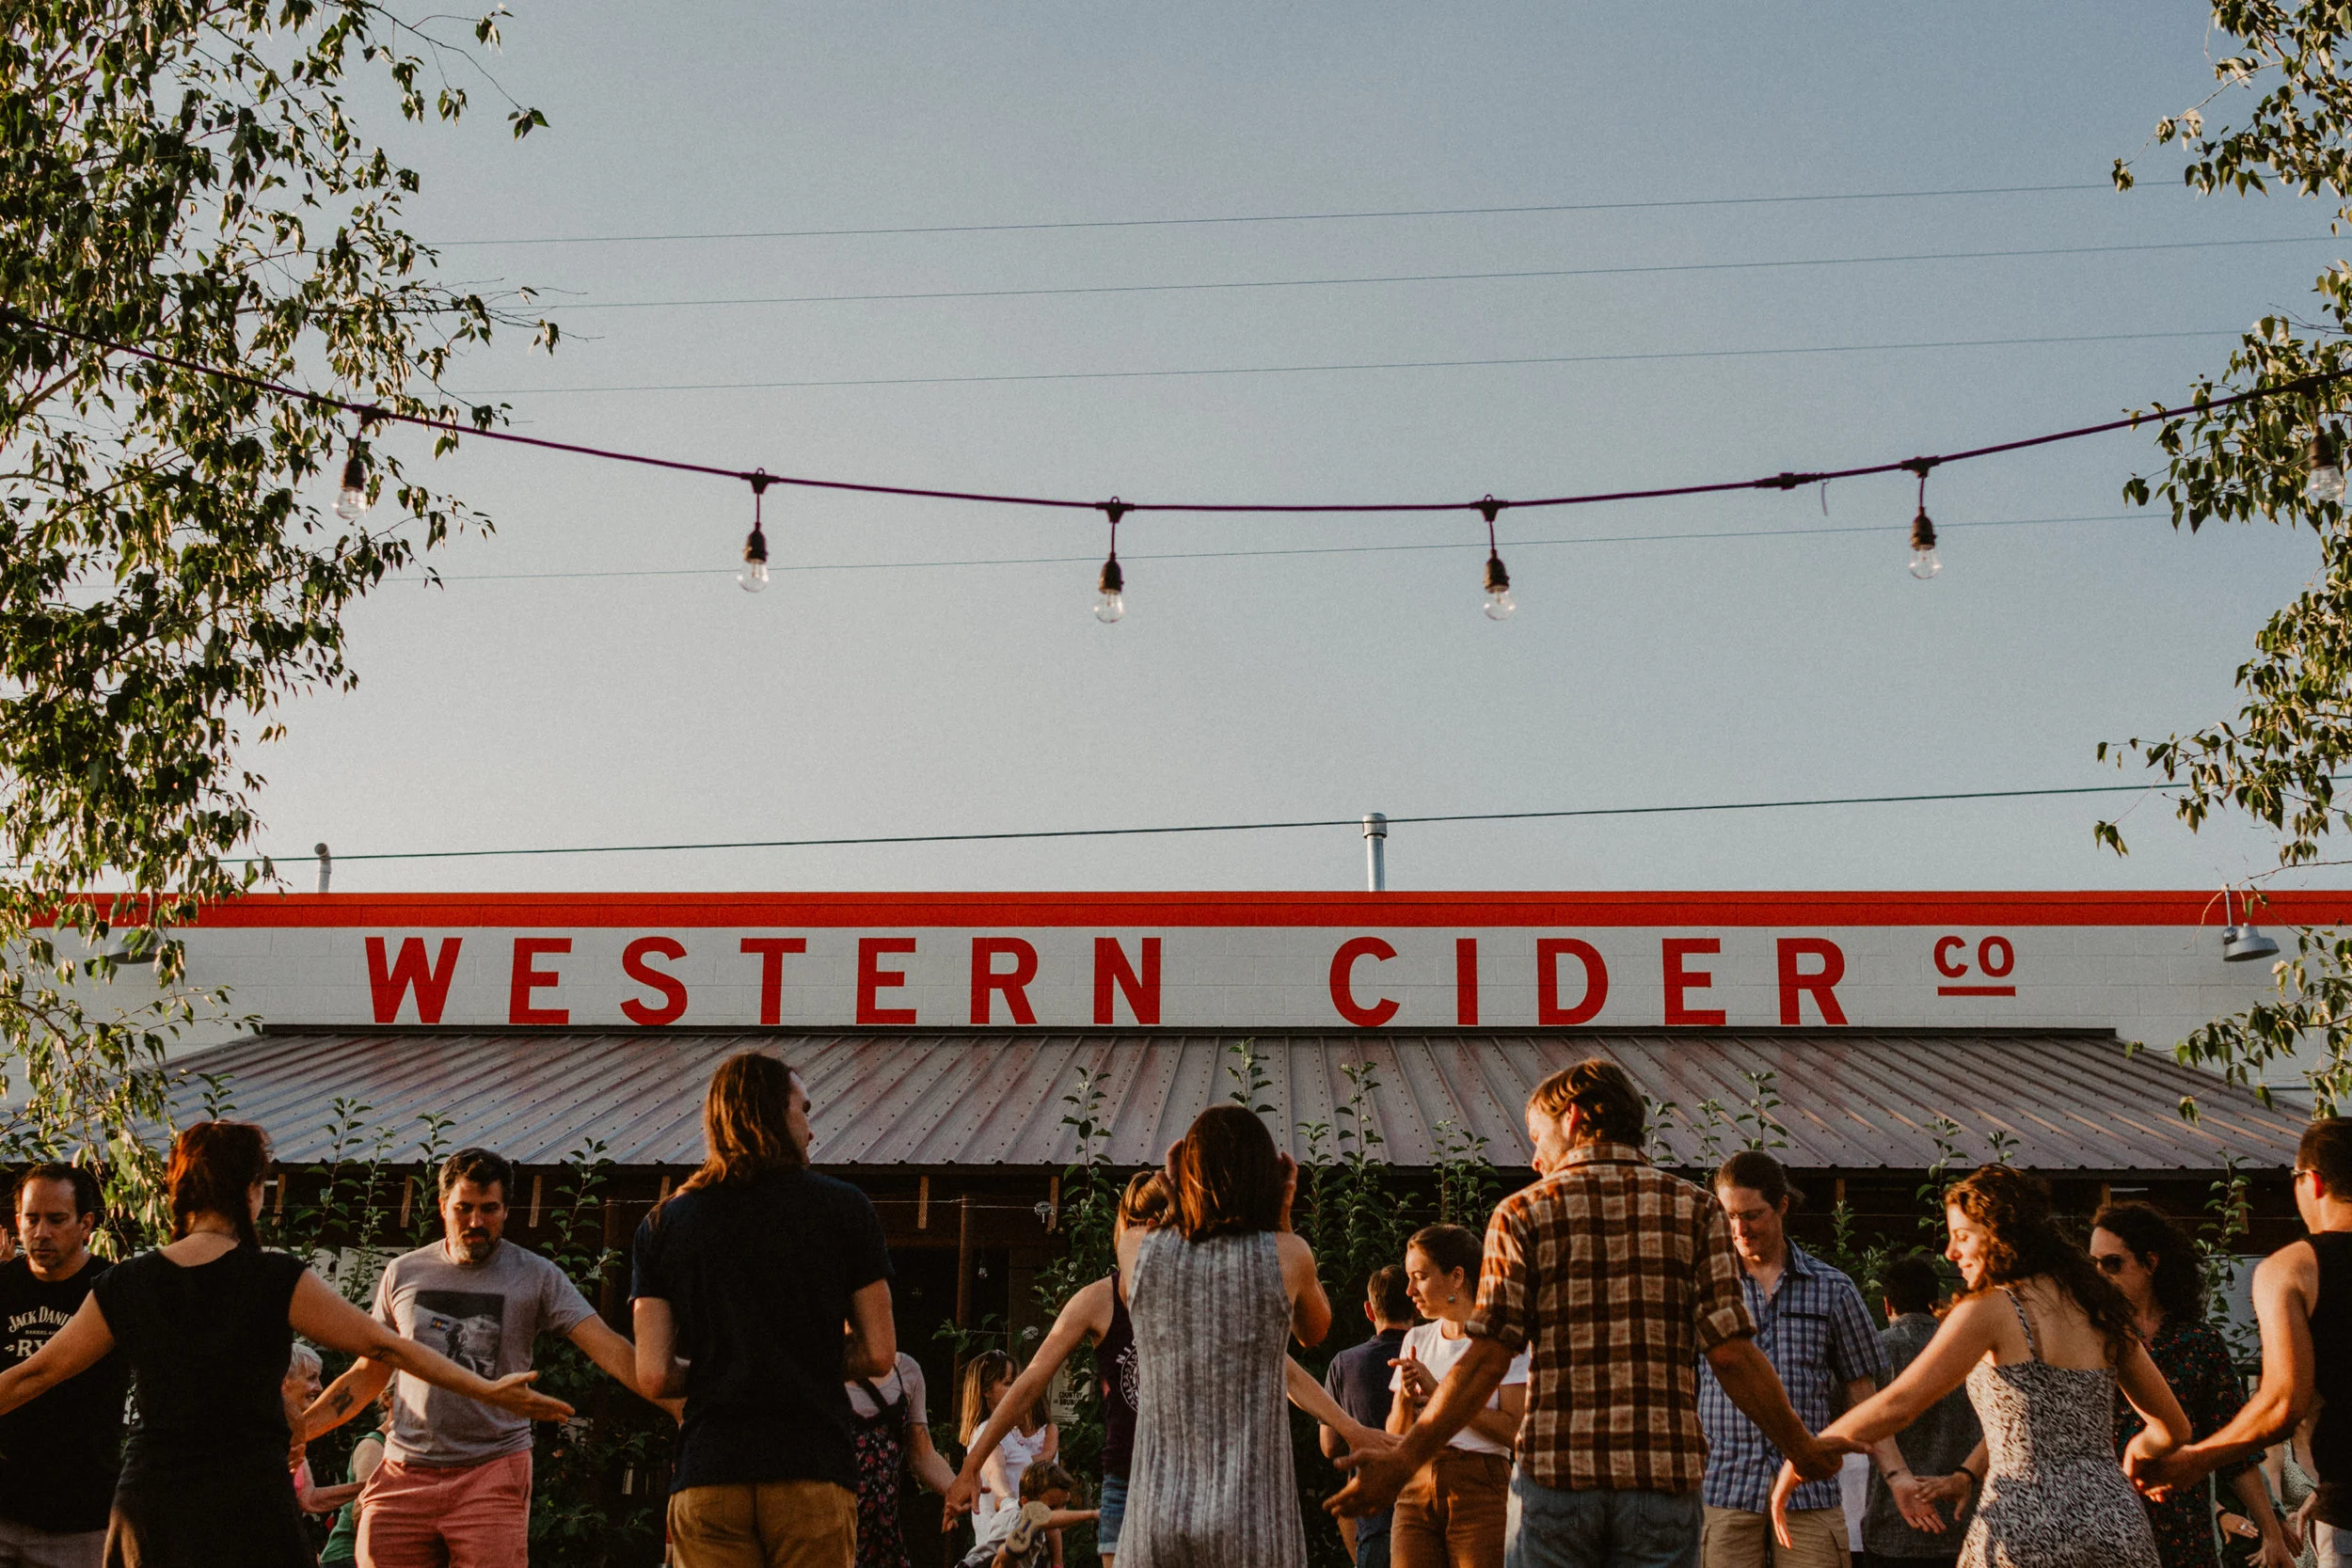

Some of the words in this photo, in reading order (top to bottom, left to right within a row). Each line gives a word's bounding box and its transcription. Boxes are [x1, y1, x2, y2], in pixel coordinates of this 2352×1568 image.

[364, 936, 1161, 1026] WESTERN
[1329, 936, 1848, 1027] CIDER
[1933, 935, 2015, 978] CO
[8, 1309, 38, 1333] JACK
